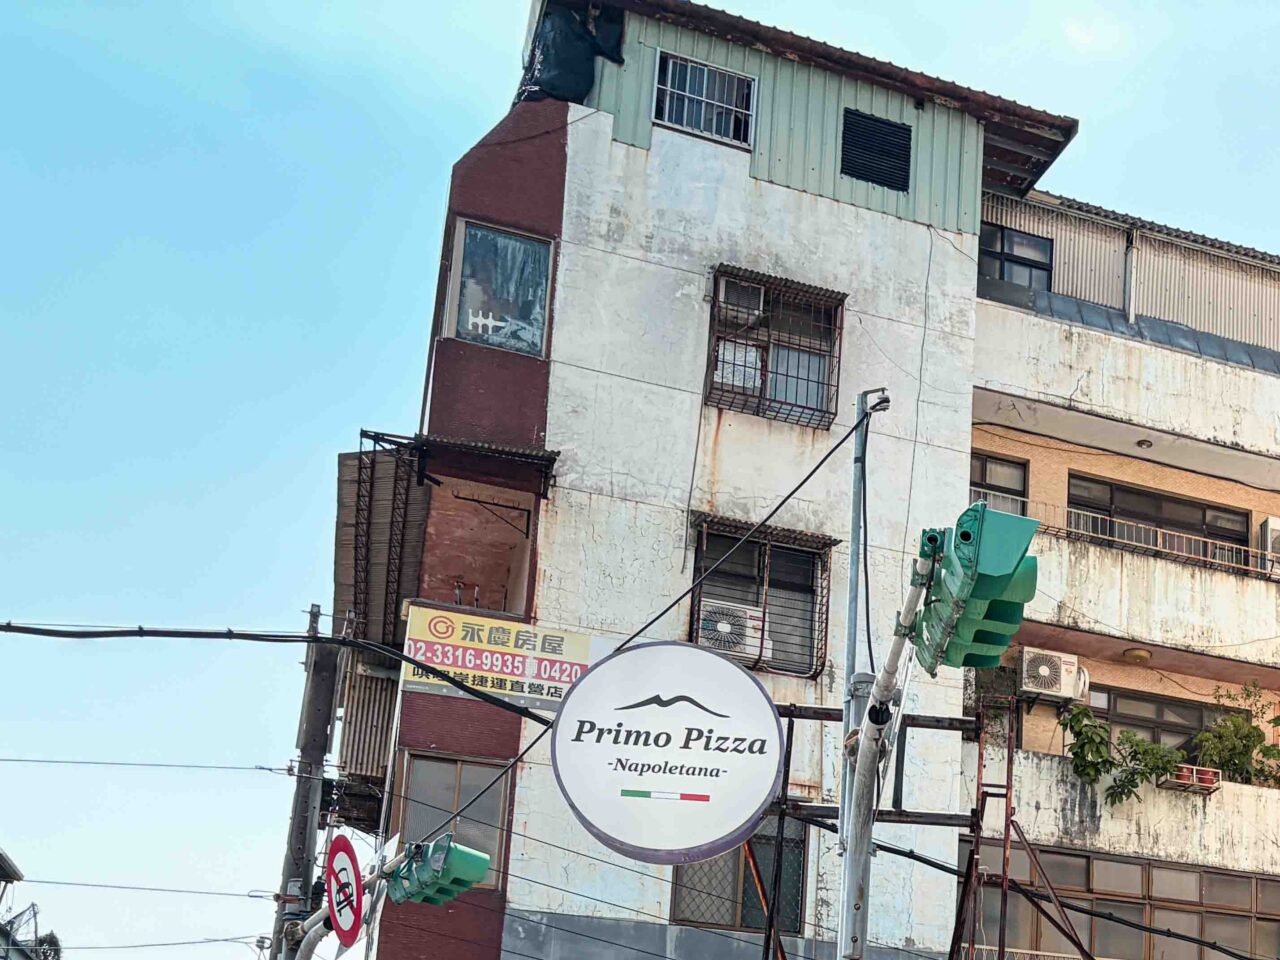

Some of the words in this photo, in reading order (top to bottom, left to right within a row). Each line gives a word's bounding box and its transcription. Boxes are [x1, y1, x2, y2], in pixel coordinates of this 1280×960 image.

[460, 620, 565, 655] 永慶房屋
[571, 719, 673, 748] Primo
[681, 726, 768, 755] Pizza
